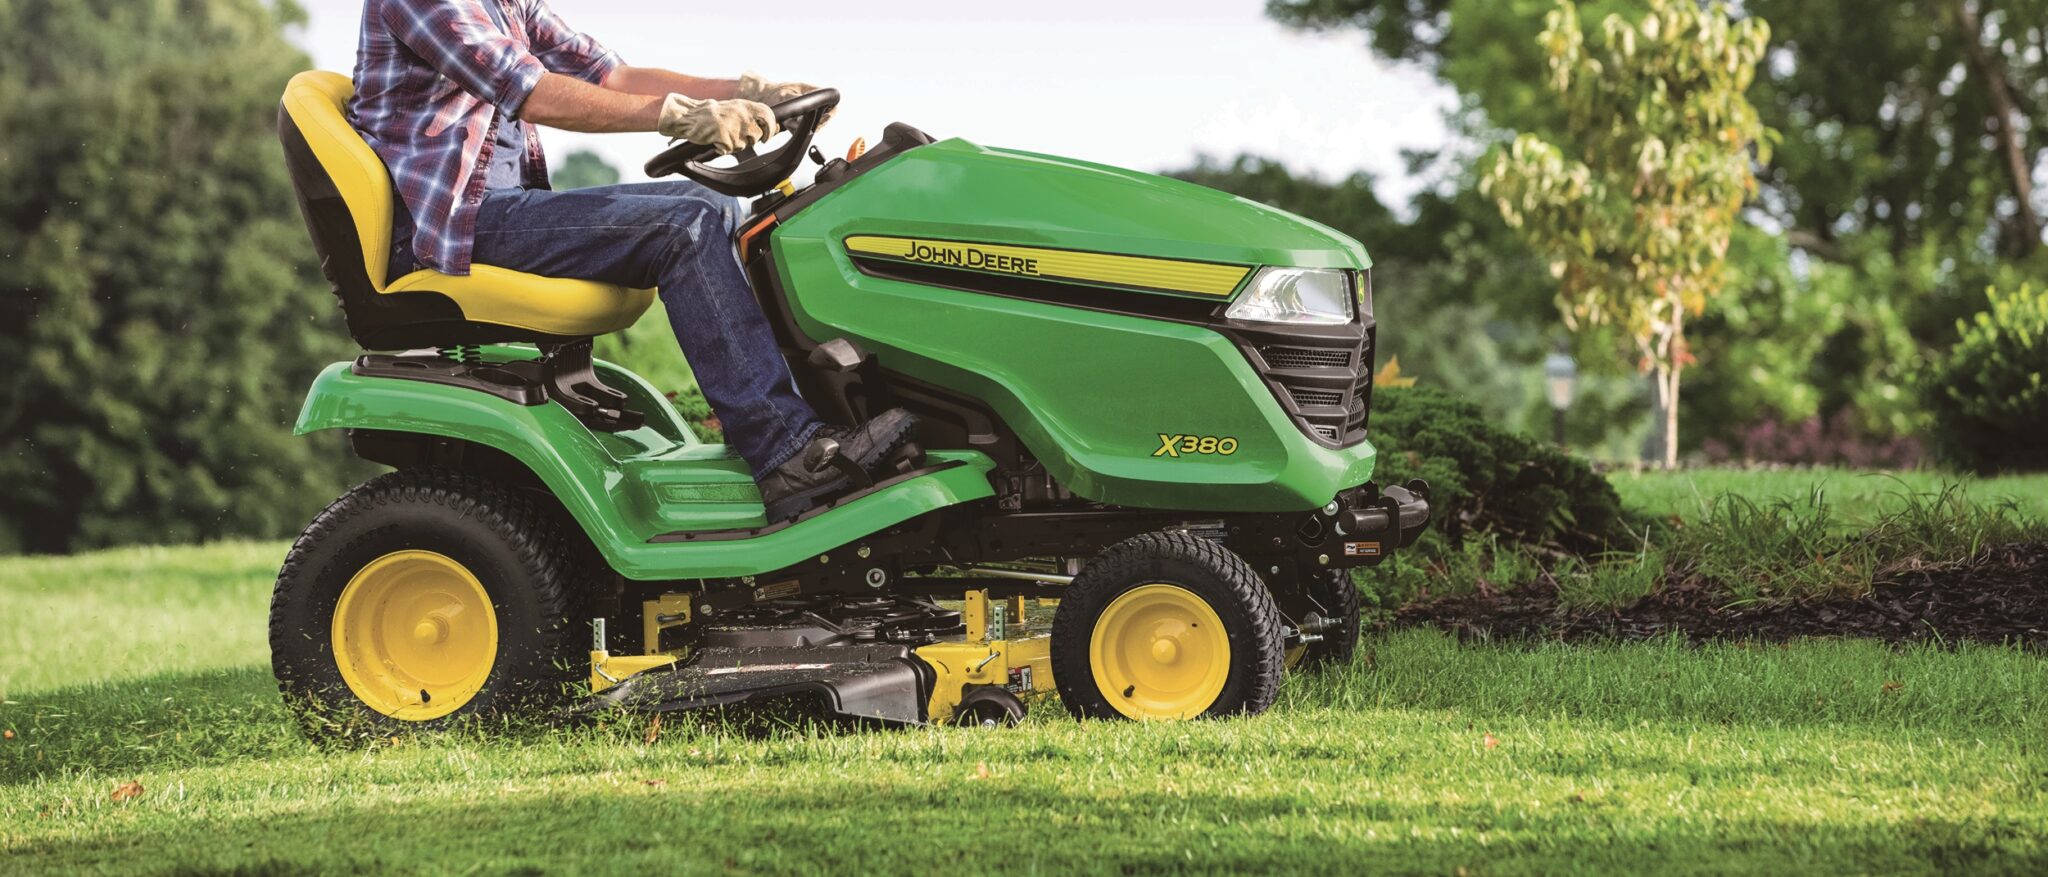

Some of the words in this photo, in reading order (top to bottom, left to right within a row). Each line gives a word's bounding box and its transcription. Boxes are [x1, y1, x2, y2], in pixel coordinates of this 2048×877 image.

[904, 241, 962, 264] JOHN
[967, 248, 1039, 274] DEERE
[1151, 433, 1238, 458] X380
